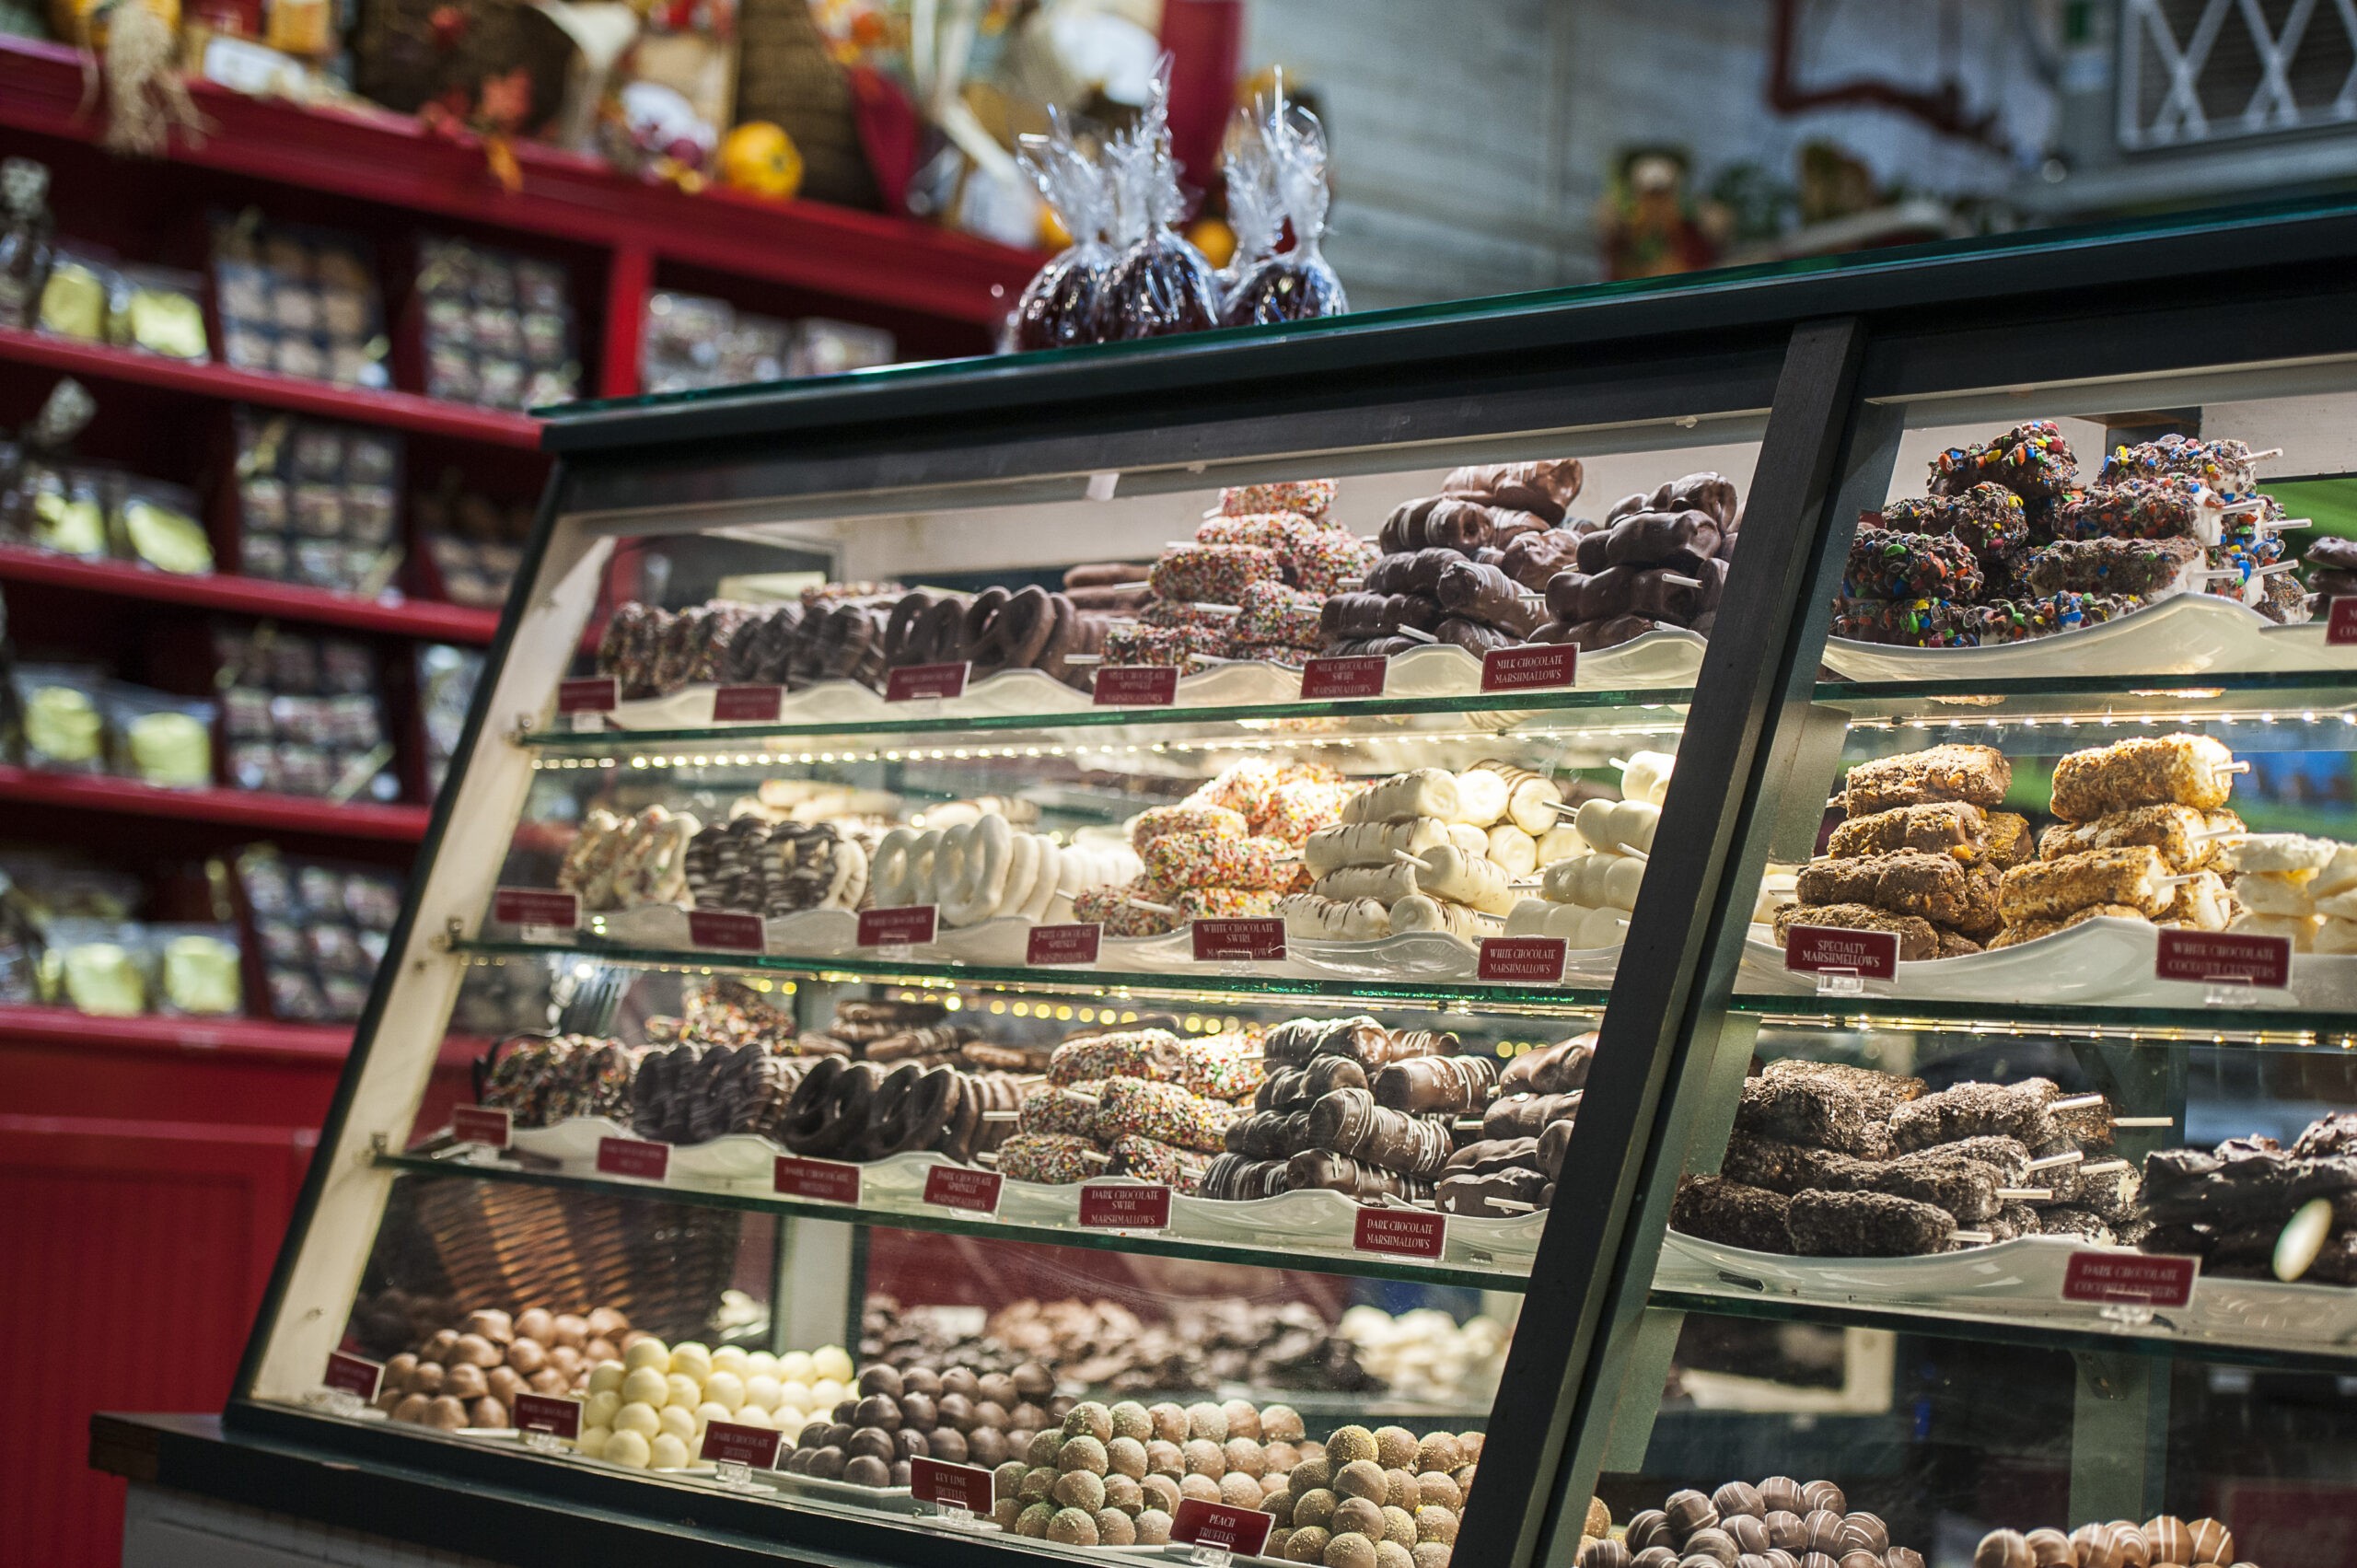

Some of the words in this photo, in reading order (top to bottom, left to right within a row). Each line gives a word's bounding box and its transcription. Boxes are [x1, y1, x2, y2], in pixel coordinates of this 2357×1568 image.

[1317, 662, 1332, 672] MILK
[1333, 660, 1375, 670] CHOCOLATE
[1497, 658, 1515, 669] MILK
[1517, 655, 1563, 668] CHOCOLATE
[1332, 671, 1353, 680] SWIRL
[1495, 669, 1562, 683] MARSHMALLOWS
[1312, 684, 1371, 694] MARSHMALLOWS
[1202, 923, 1228, 934] WHITE
[1229, 923, 1274, 933] CHOCOLATE
[1225, 934, 1252, 944] SWIRL
[1490, 948, 1513, 958] WHITE
[1514, 948, 1556, 959] CHOCOLATE
[1817, 940, 1867, 955] SPECIALTY
[2212, 945, 2275, 960] CHOCOLATE
[1802, 950, 1880, 967] MARSHMELLOWS
[1489, 963, 1550, 974] MARSHMALLOWS
[936, 1170, 954, 1181] DARK
[955, 1173, 993, 1187] CHOCOLATE
[933, 1192, 986, 1209] MARSHMALLOWS
[1092, 1190, 1113, 1200] DARK
[1114, 1190, 1159, 1201] CHOCOLATE
[1112, 1201, 1137, 1210] SWIRL
[1091, 1214, 1155, 1225] MARSHMALLOWS
[1367, 1218, 1388, 1231] DARK
[1389, 1220, 1434, 1235] CHOCOLATE
[1366, 1234, 1431, 1249] MARSHMALLOWS
[2114, 1266, 2178, 1282] CHOCOLATE
[935, 1472, 948, 1482] KEY
[949, 1474, 967, 1487] LIME
[935, 1485, 967, 1501] TRUFFLES
[1209, 1513, 1236, 1528] PEACH
[1199, 1527, 1235, 1543] TRUFFLES
